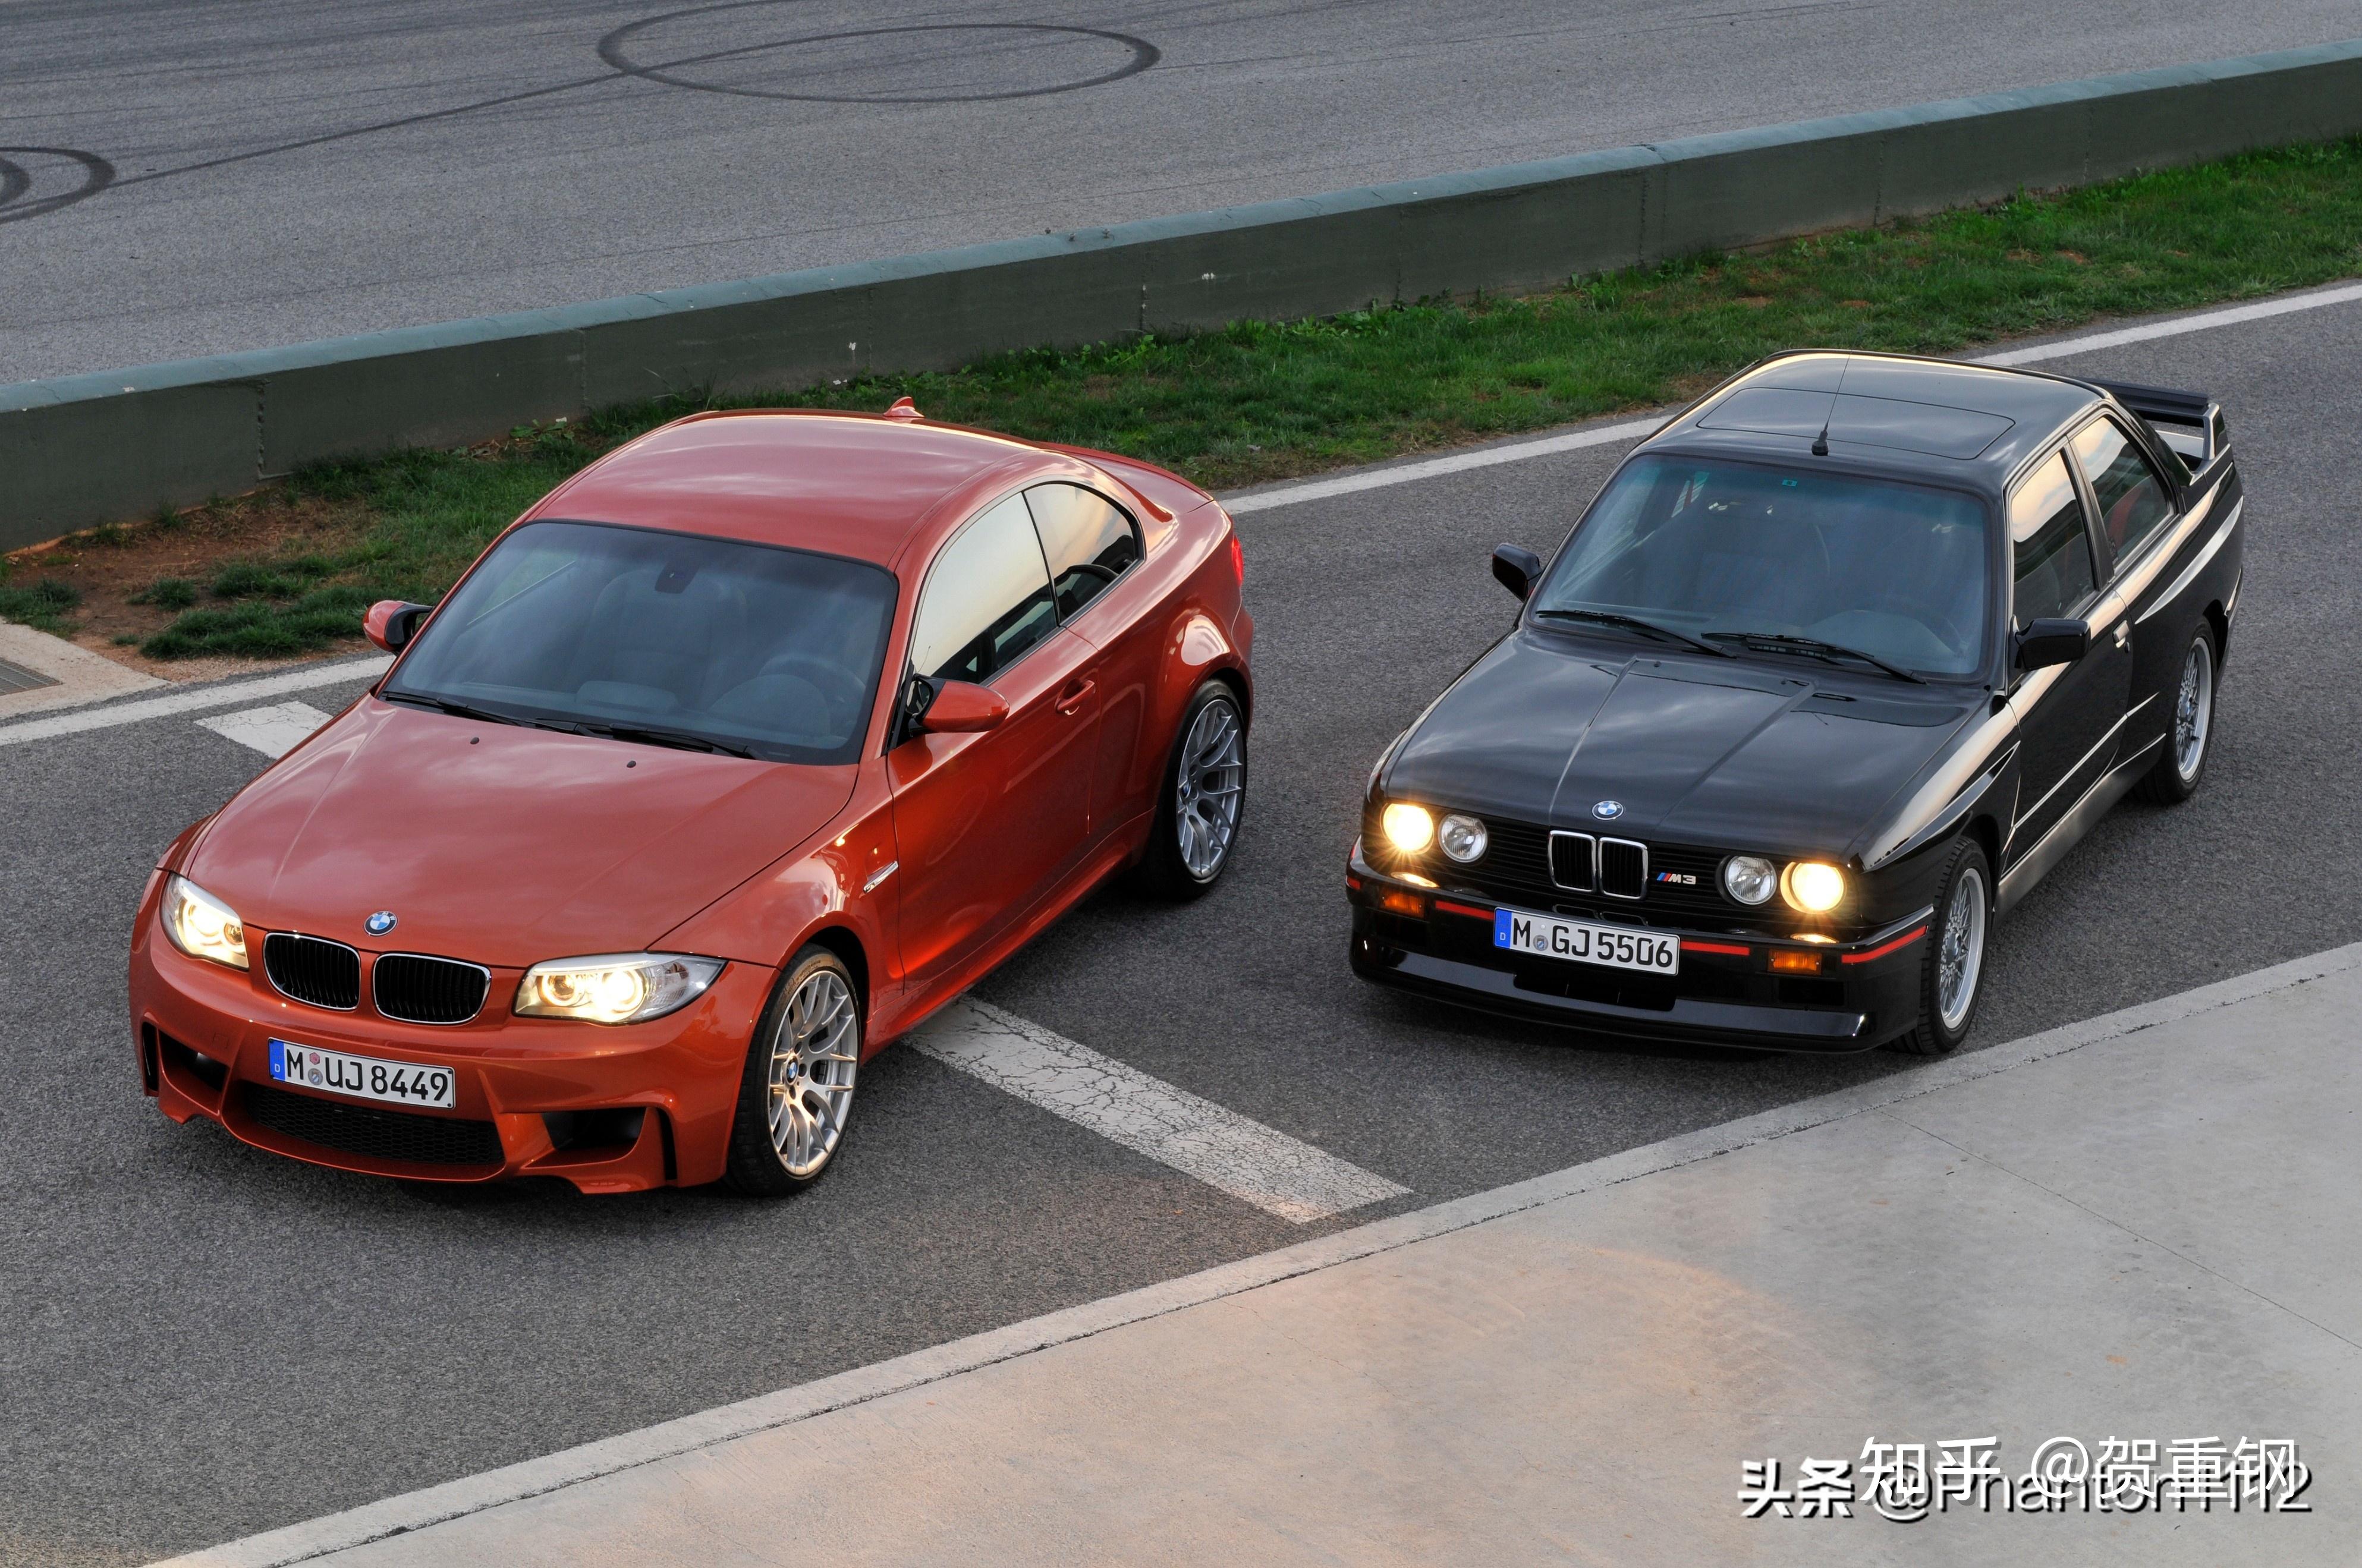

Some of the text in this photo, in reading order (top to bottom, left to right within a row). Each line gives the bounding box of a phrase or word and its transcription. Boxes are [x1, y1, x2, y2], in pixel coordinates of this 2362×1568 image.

[1666, 873, 1696, 884] M3
[1499, 932, 1506, 941] D
[1512, 918, 1673, 968] M GJ 5506
[274, 1063, 281, 1072] D
[287, 1049, 448, 1101] M UJ 8449
